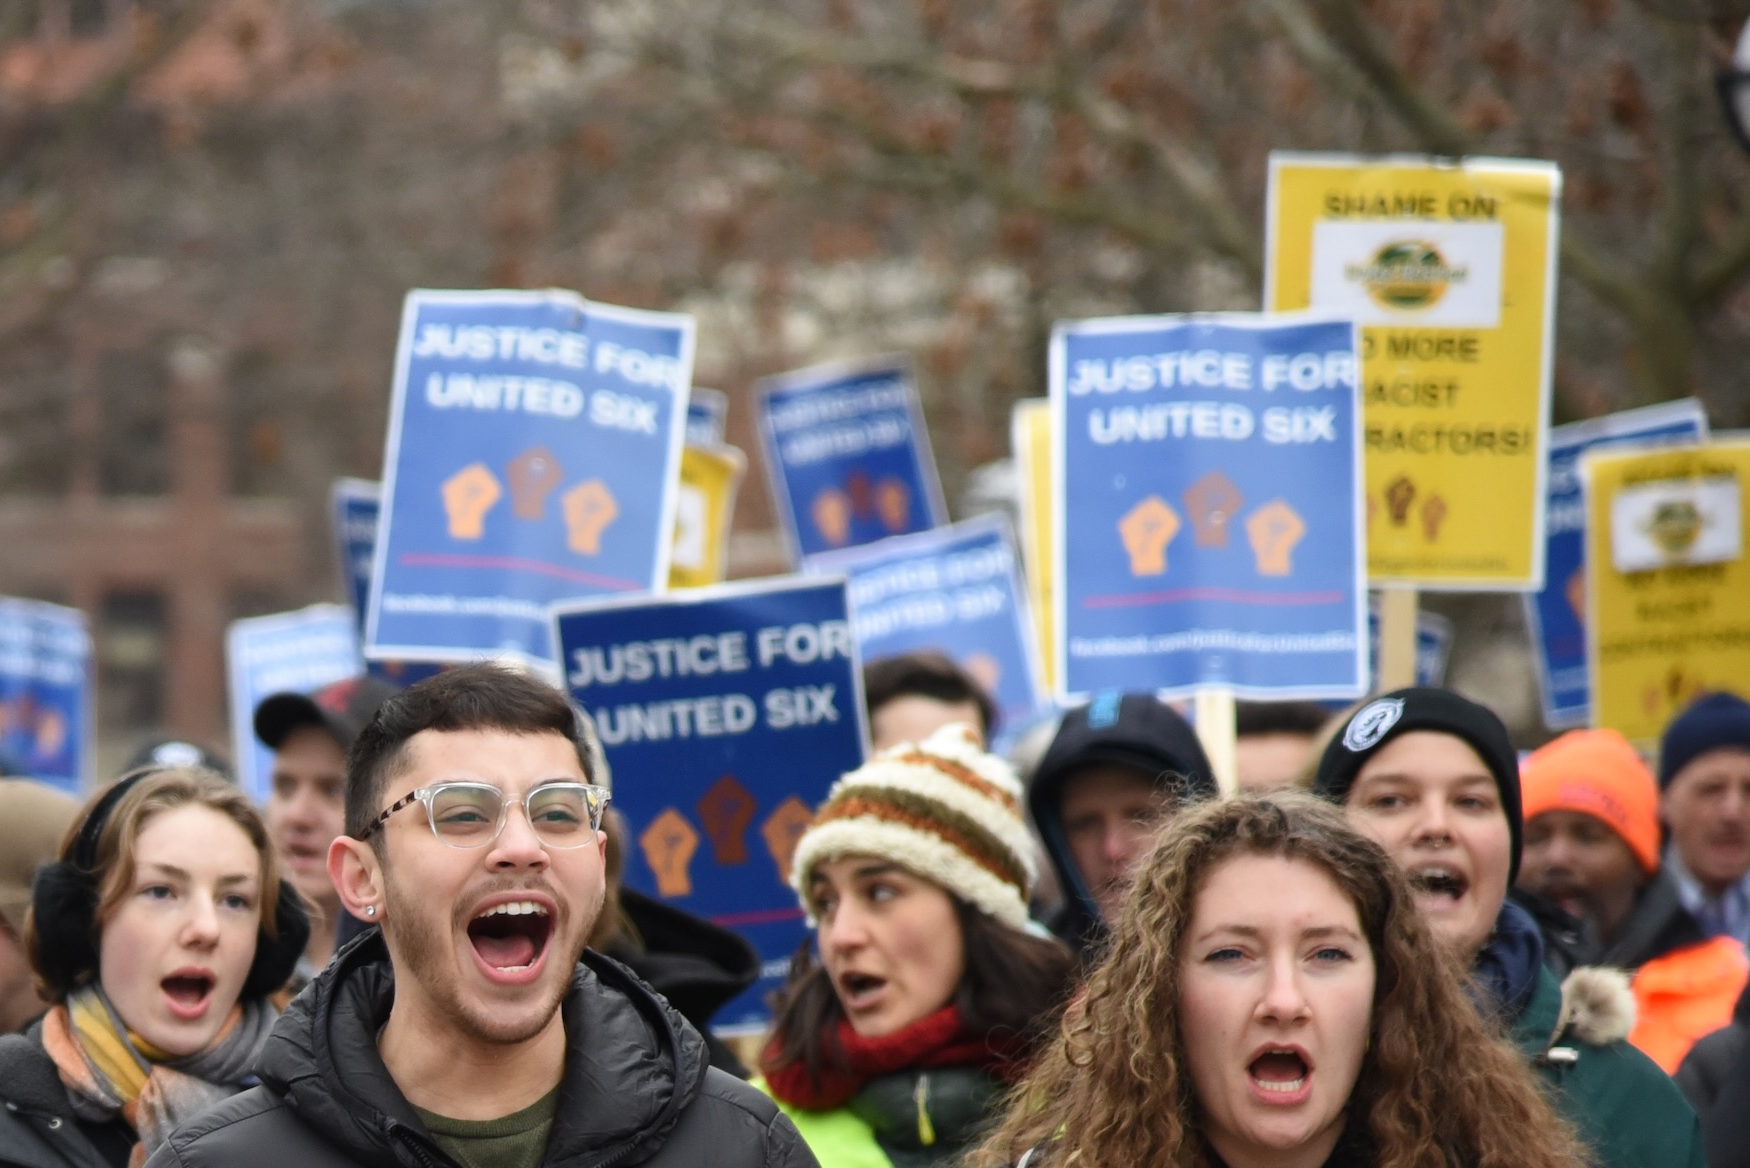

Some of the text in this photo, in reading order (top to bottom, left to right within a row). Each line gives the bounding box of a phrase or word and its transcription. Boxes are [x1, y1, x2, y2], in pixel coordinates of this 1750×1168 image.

[1323, 193, 1498, 220] SHAME ON
[413, 322, 682, 392] JUSTICE FOR
[1386, 334, 1481, 364] MORE
[1069, 351, 1356, 395] JUSTICE FOR
[1362, 378, 1460, 409] ACIST
[425, 372, 584, 418] UNITED
[590, 389, 658, 434] SIX
[1089, 401, 1337, 444] UNITED SIX
[1365, 425, 1531, 456] RACTORS!
[569, 620, 851, 687] JUSTICE FOR
[596, 682, 840, 745] UNITED SIX
